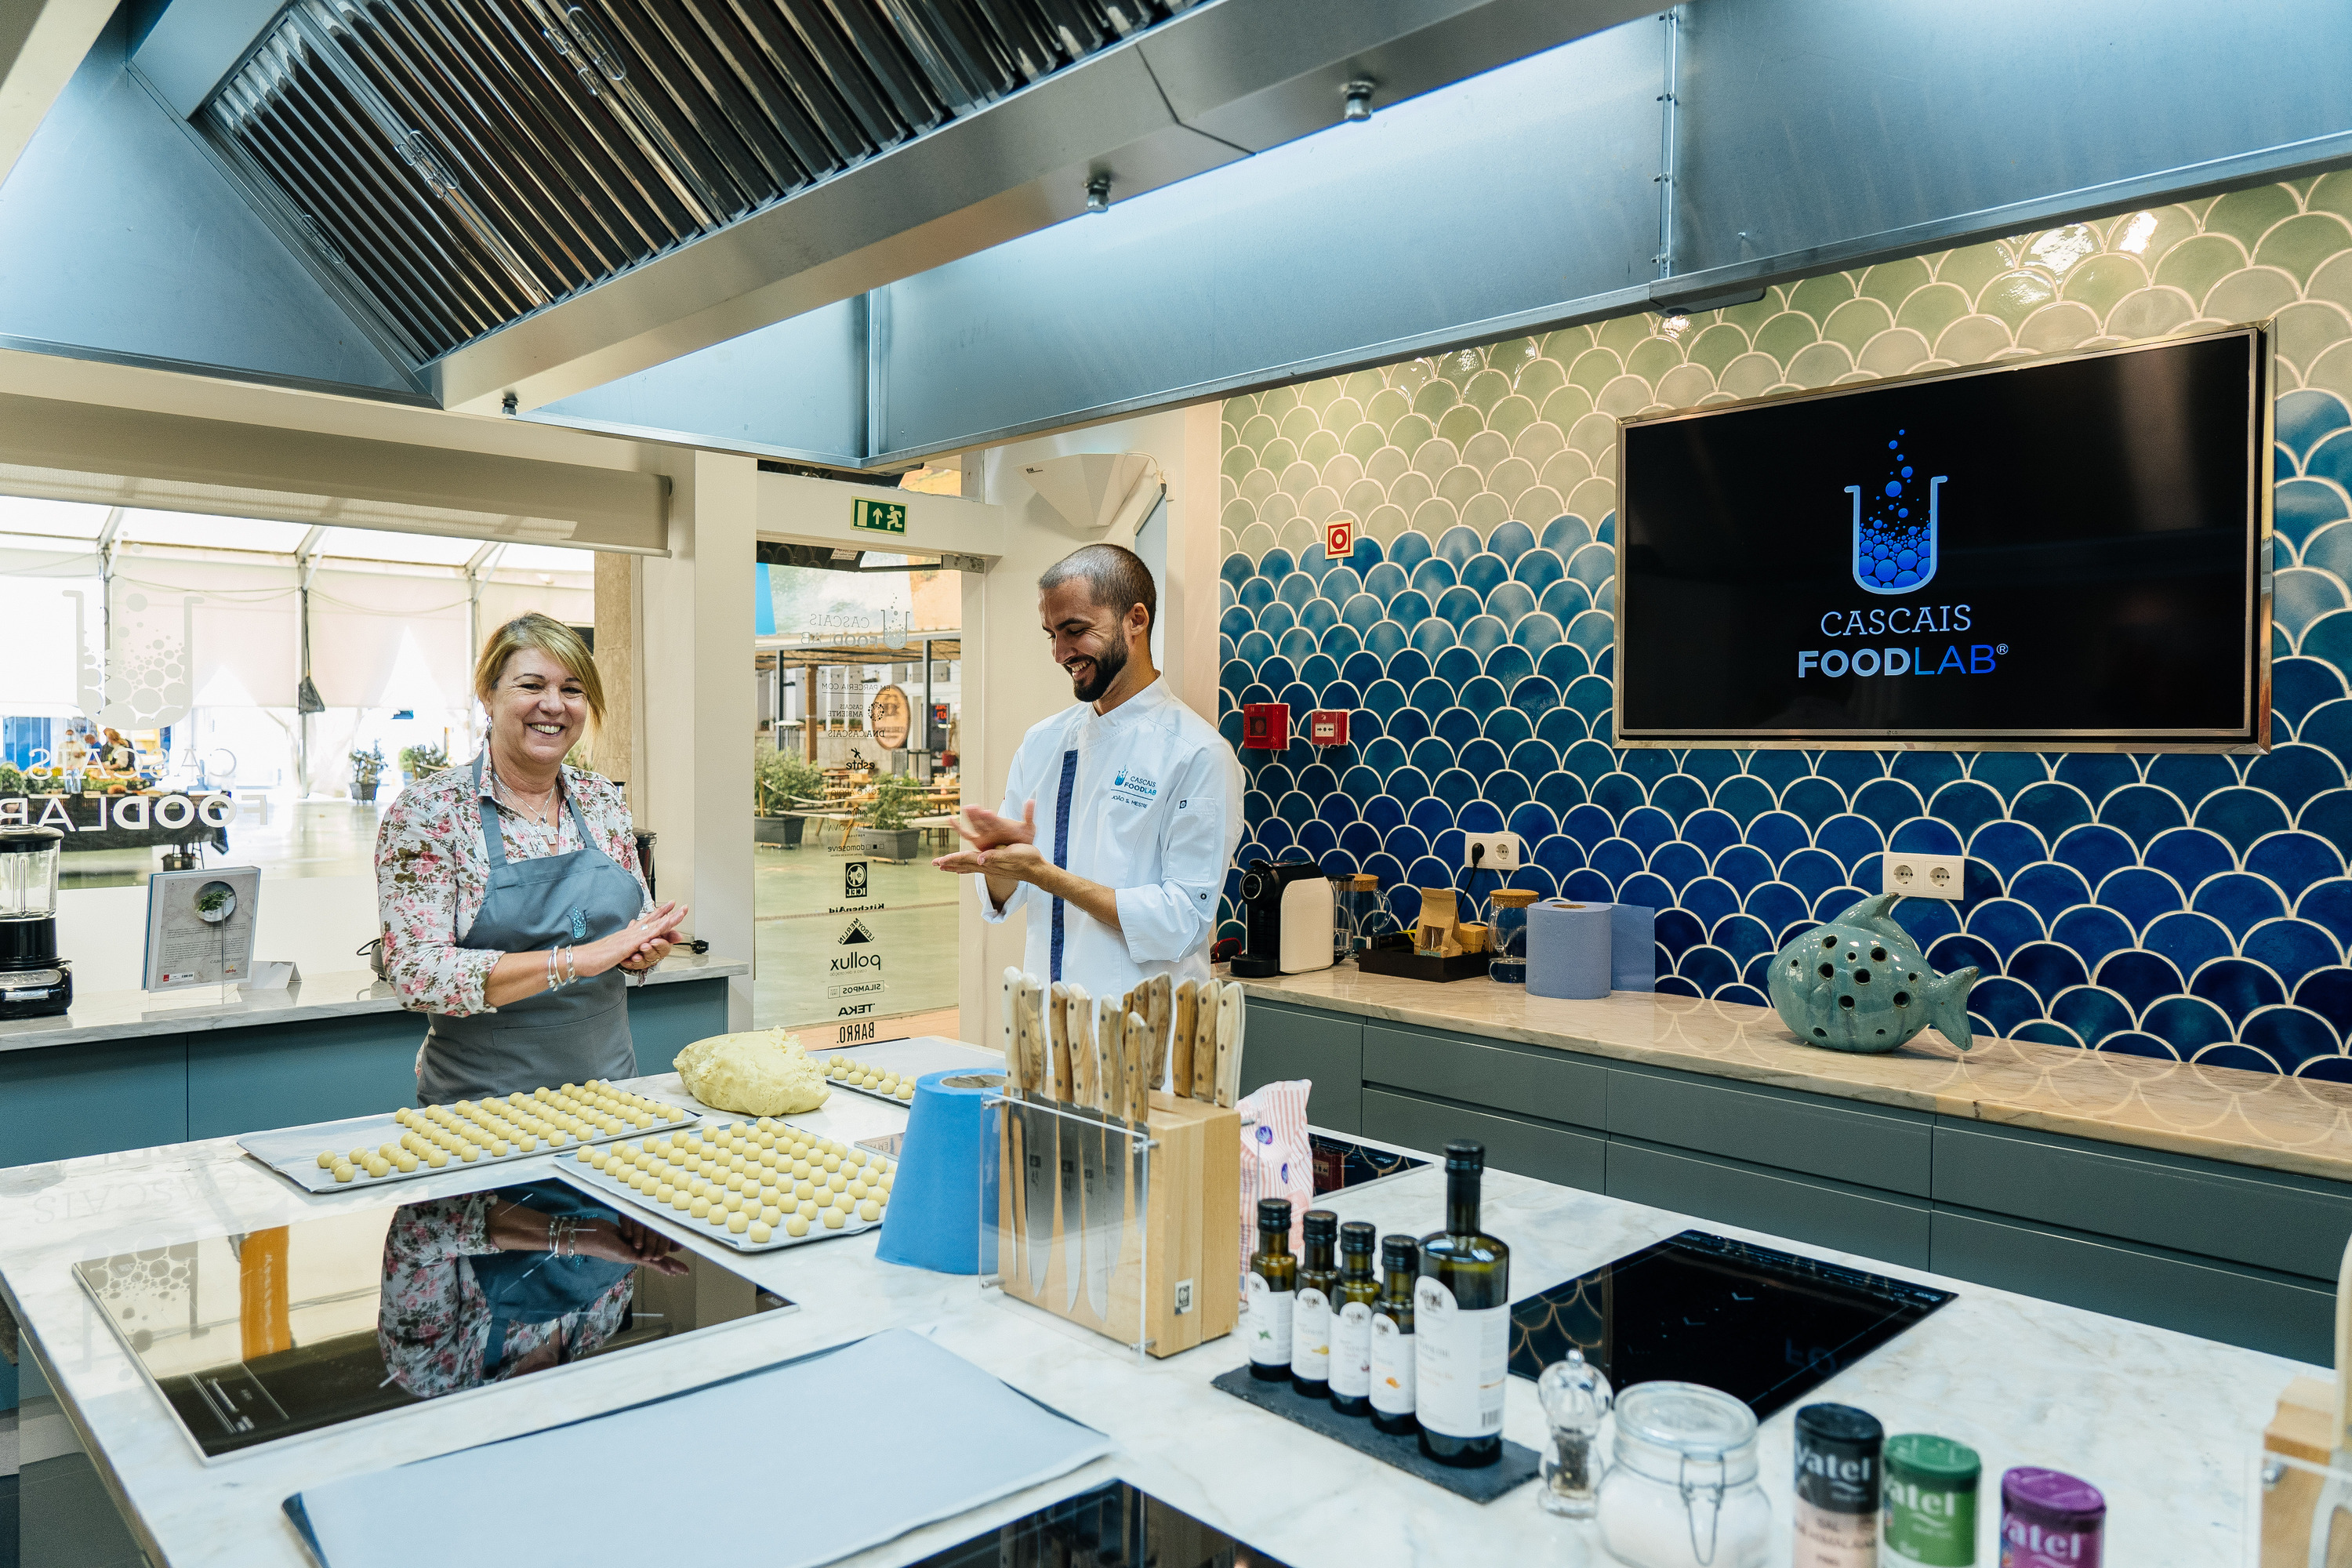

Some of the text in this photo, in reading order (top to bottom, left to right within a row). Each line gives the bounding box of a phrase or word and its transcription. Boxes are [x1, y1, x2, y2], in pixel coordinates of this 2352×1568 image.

[1820, 604, 1971, 637] CASCAIS
[1130, 775, 1156, 788] CASCAIS
[1123, 782, 1157, 796] FOODLAB
[1131, 800, 1148, 809] MESTRE
[1795, 1441, 1871, 1482] Vatel
